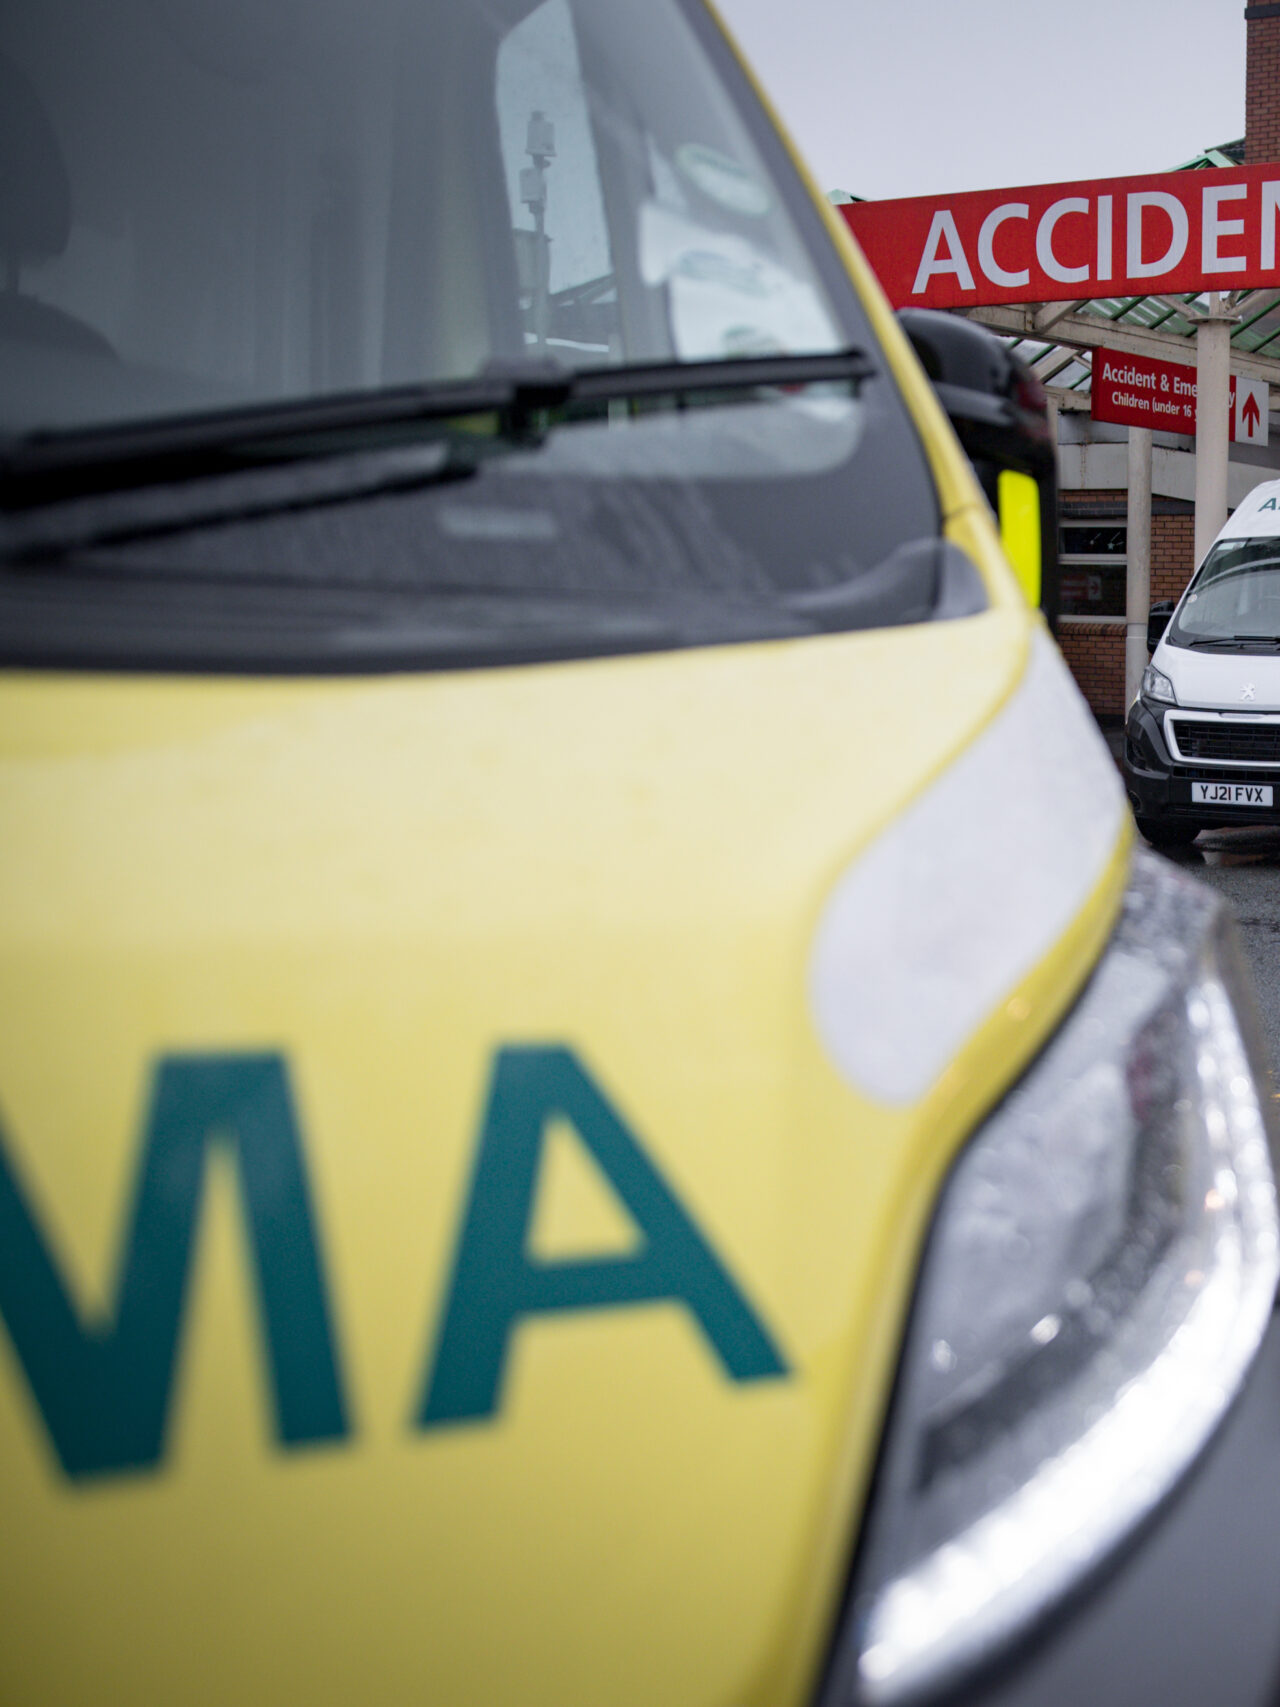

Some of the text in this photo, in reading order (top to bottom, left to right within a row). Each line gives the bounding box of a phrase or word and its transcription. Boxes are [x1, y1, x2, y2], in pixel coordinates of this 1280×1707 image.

[1102, 362, 1157, 390] Accident
[1160, 374, 1170, 392] &
[1111, 391, 1150, 410] Children
[1152, 397, 1181, 415] (under
[1183, 405, 1192, 417] 16
[1200, 785, 1263, 802] YJ21 FVX
